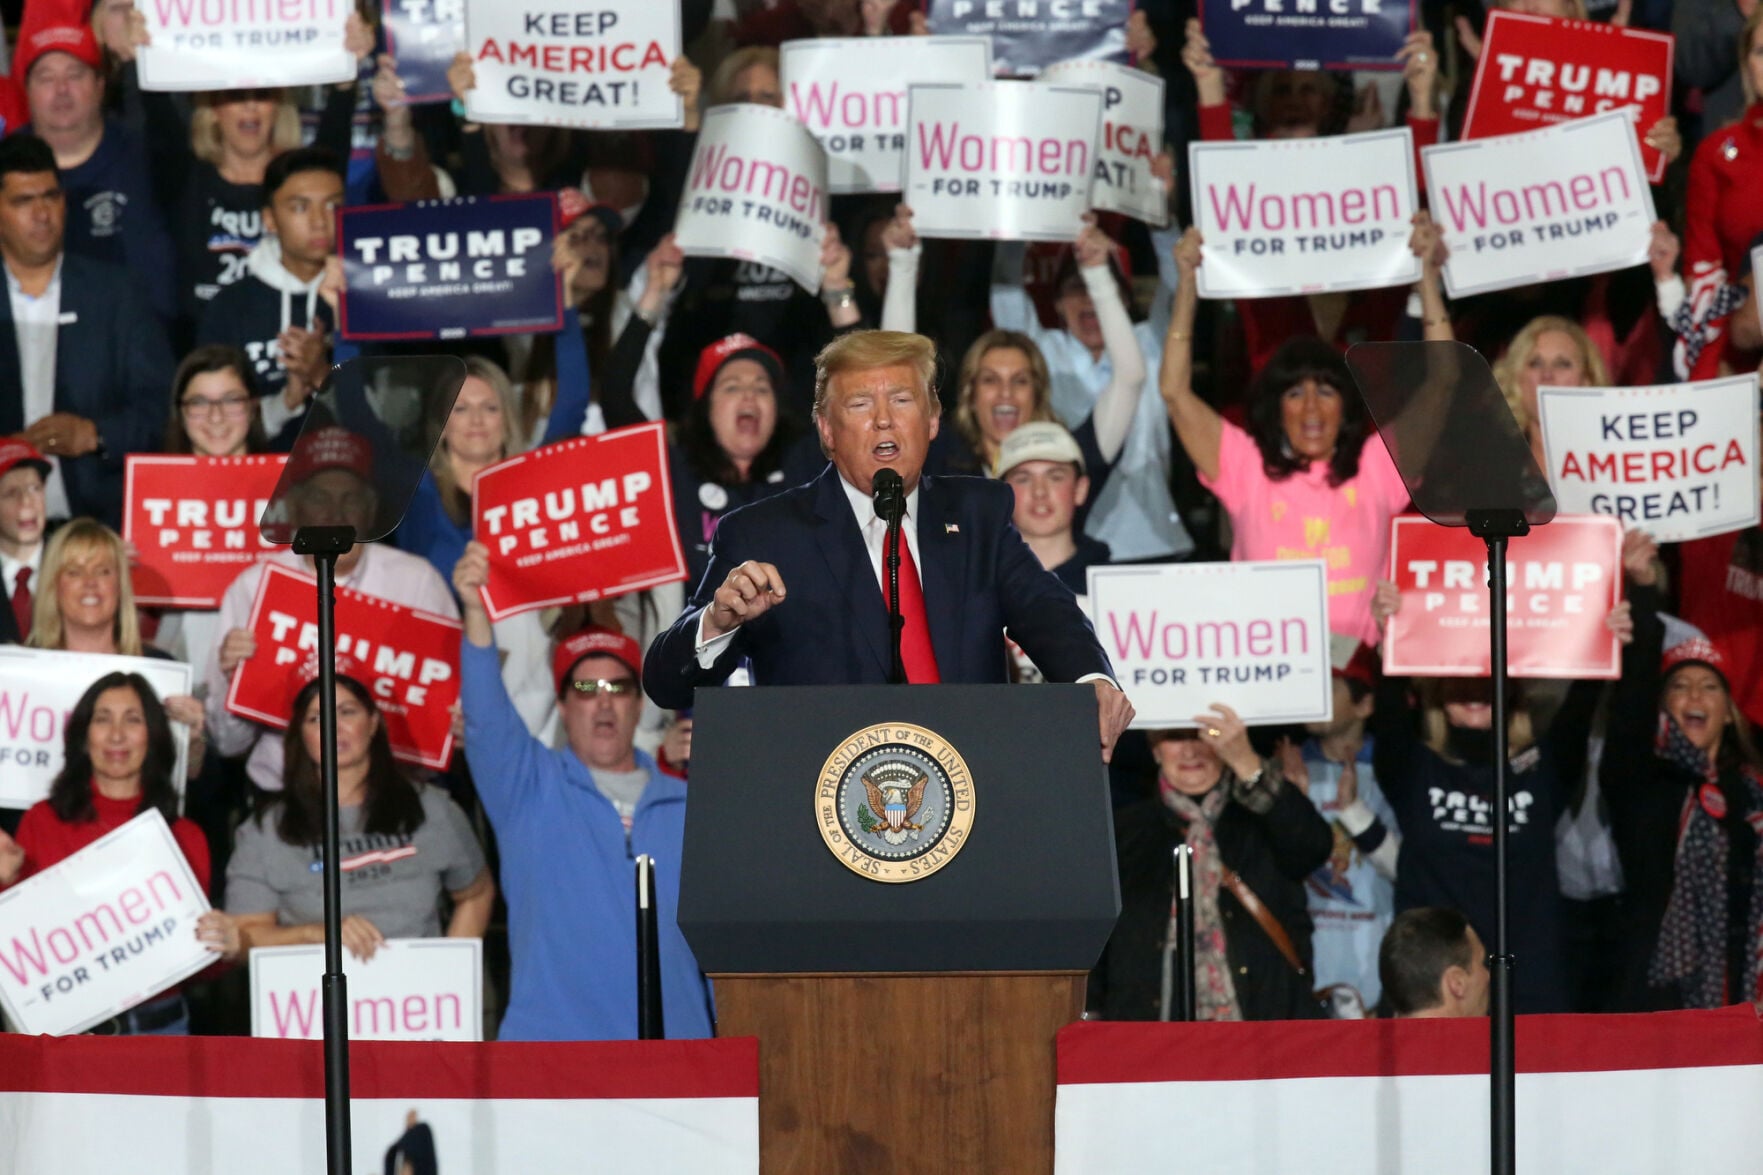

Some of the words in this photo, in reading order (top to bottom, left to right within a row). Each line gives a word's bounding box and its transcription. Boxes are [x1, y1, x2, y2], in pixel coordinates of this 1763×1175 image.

[524, 11, 618, 36] KEEP
[953, 0, 1102, 18] PENCE
[174, 33, 223, 48] FOR
[234, 28, 319, 46] TRUMP
[477, 37, 667, 74] AMERICA
[506, 74, 639, 107] GREAT!
[1497, 53, 1661, 101] TRUMP
[790, 80, 906, 128] Wom
[917, 120, 1088, 176] Women
[691, 143, 827, 224] Women
[933, 178, 979, 196] FOR
[990, 179, 1073, 200] TRUMP
[1441, 166, 1630, 233] Women
[692, 197, 732, 216] FOR
[743, 201, 812, 238] TRUMP
[1208, 182, 1401, 233] Women
[354, 227, 542, 264] TRUMP
[1233, 237, 1286, 255] FOR
[1295, 229, 1385, 252] TRUMP
[1473, 229, 1525, 253] FOR
[1532, 212, 1619, 243] TRUMP
[373, 257, 526, 286] PENCE
[1601, 410, 1698, 440] KEEP
[1560, 438, 1747, 483] AMERICA
[143, 499, 289, 527] TRUM
[483, 471, 652, 535] TRUMP
[1591, 482, 1720, 521] GREAT!
[159, 529, 276, 549] PENC
[499, 506, 640, 556] PENCE
[1108, 610, 1309, 662] Women
[275, 646, 428, 707] PCE
[1133, 668, 1187, 686] FOR
[1198, 663, 1292, 685] TRUMP
[895, 729, 909, 741] OF
[913, 732, 935, 749] THE
[820, 728, 891, 800] PRESIDENT
[936, 747, 970, 812] UNITED
[822, 804, 835, 827] THE
[829, 829, 842, 844] OF
[910, 825, 964, 875] STATES
[843, 841, 882, 875] SEAL
[0, 870, 183, 986] Women
[40, 967, 91, 1001] FOR
[94, 917, 178, 970] TRUMP
[269, 988, 462, 1038] Wmen
